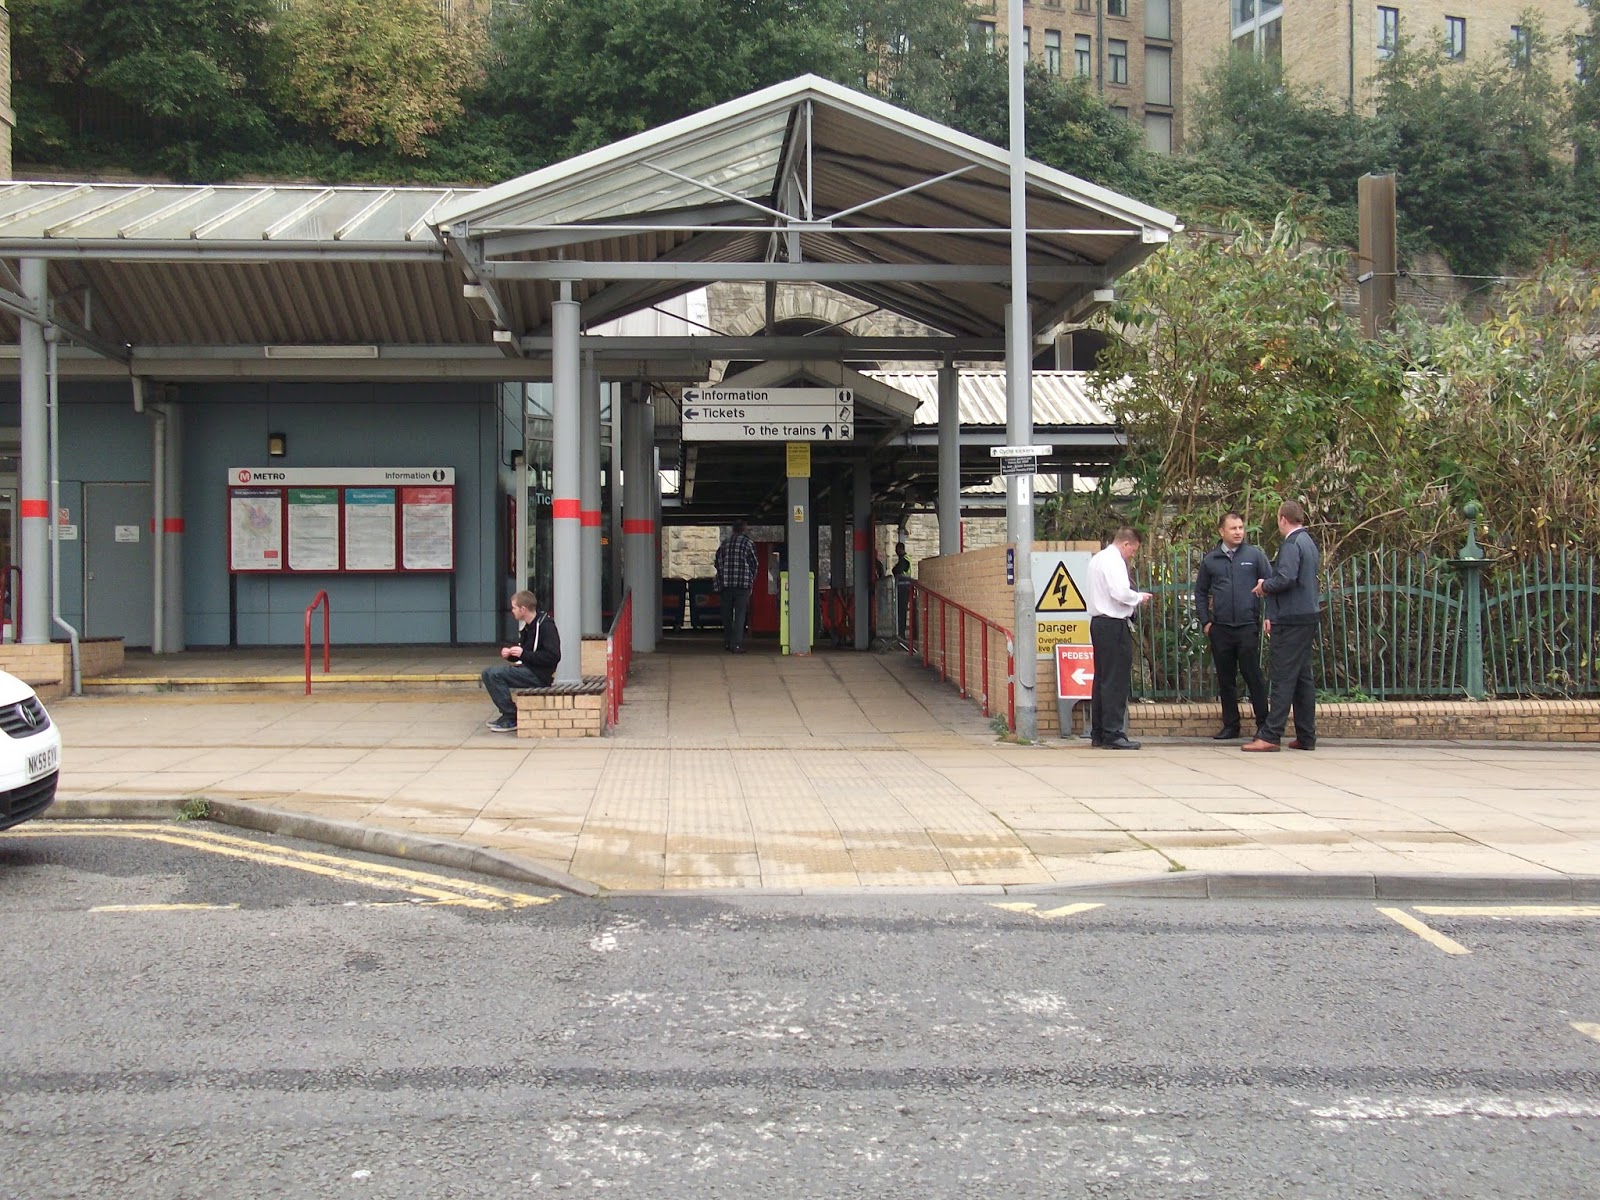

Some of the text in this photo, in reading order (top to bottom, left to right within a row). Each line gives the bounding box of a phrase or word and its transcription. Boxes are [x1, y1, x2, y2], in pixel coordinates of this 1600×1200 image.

[701, 390, 768, 401] Information
[702, 408, 745, 418] Tickets
[743, 425, 817, 436] To the trains
[253, 472, 286, 480] METRO
[385, 471, 431, 480] Information
[535, 492, 553, 505] Tic
[1037, 622, 1078, 634] Danger
[1038, 636, 1072, 644] Overhead
[1038, 645, 1051, 653] live
[28, 752, 47, 774] NK59
